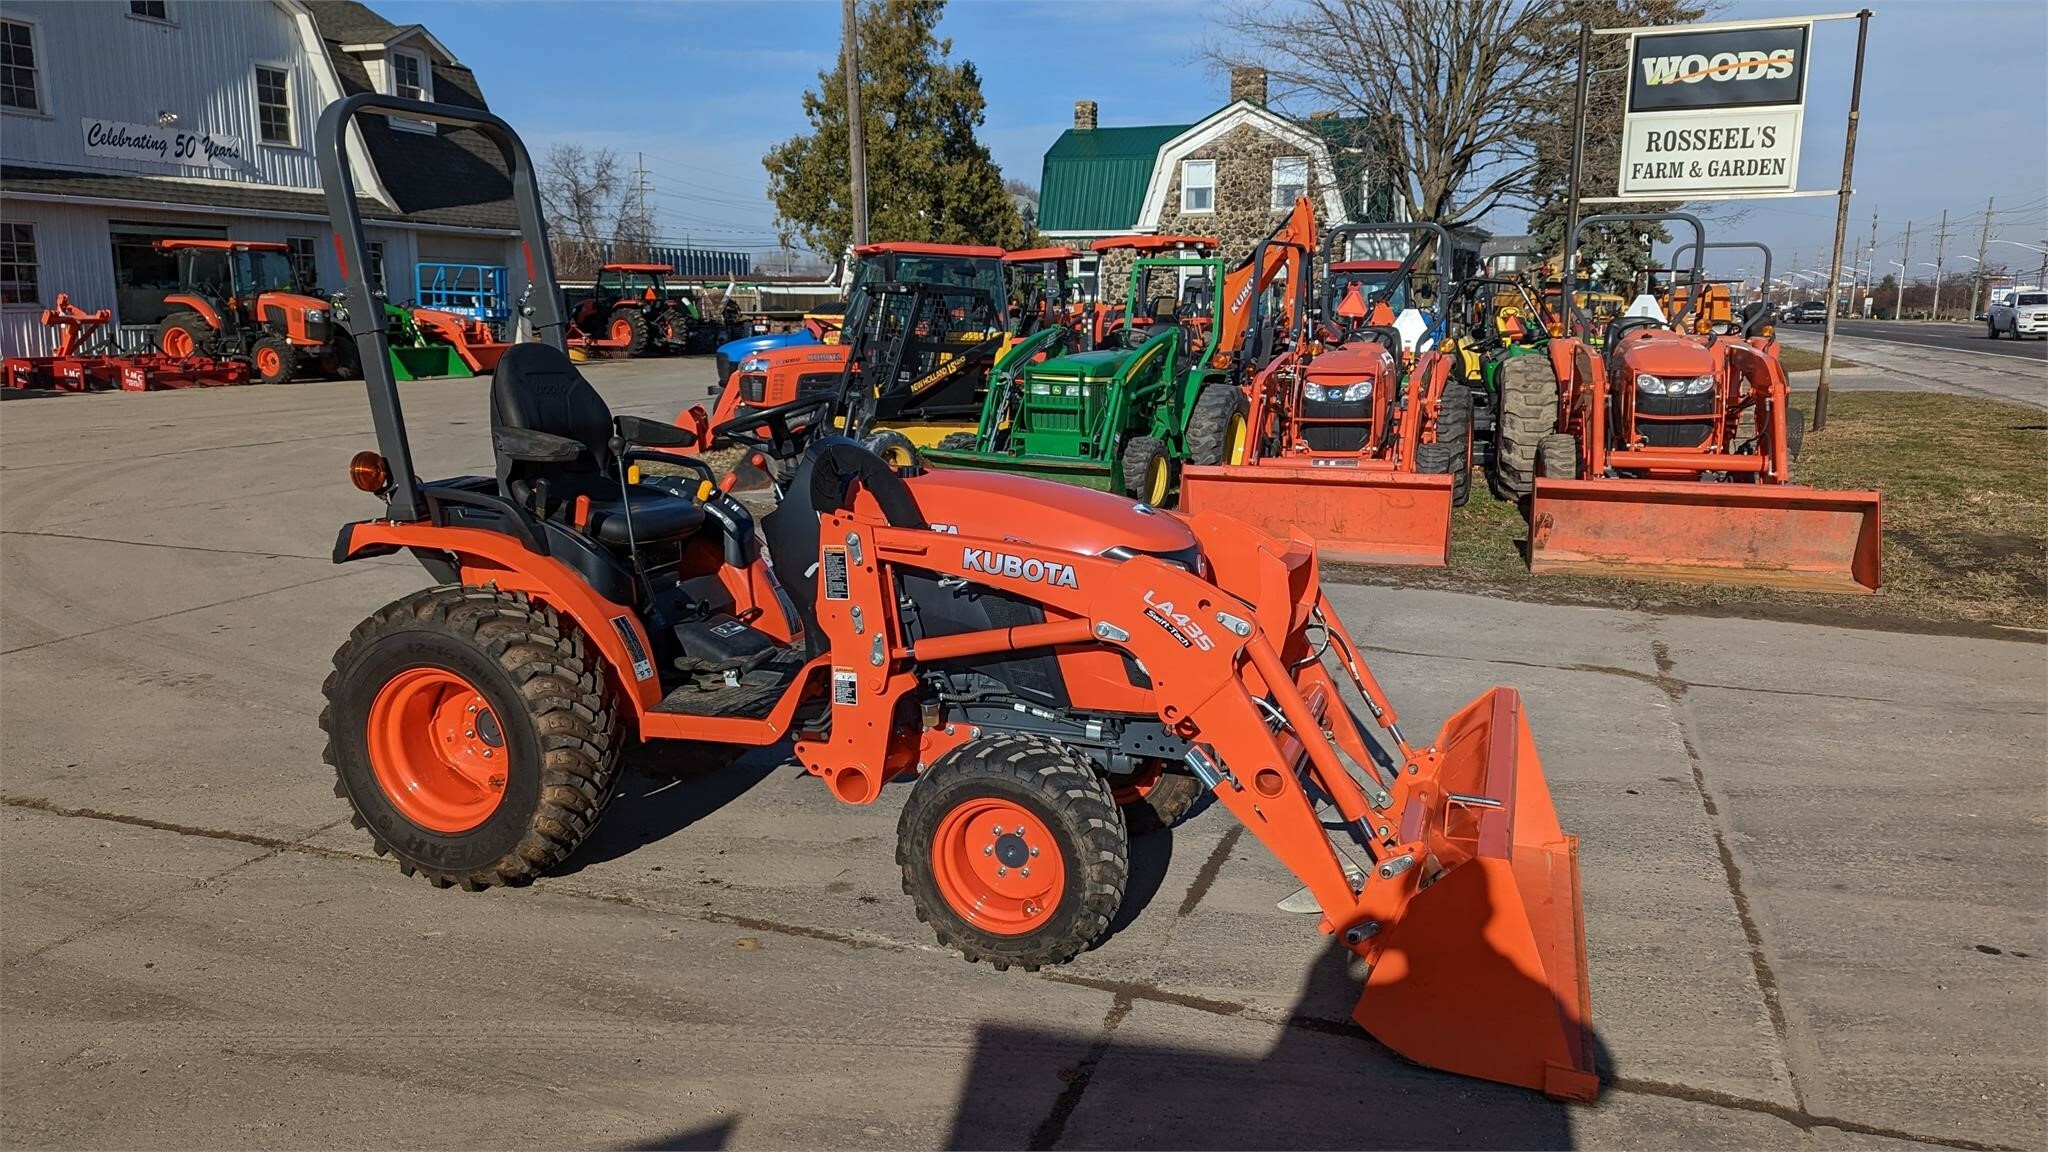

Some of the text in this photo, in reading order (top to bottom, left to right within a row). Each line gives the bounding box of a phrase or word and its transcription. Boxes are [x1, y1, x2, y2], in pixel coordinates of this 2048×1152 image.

[1641, 48, 1795, 86] WOODS
[87, 122, 240, 161] Celebrating 50 Years
[1645, 125, 1777, 153] ROSSEEL'S
[1631, 158, 1787, 180] FARM & GARDEN
[1231, 278, 1254, 314] KUBO
[923, 366, 948, 387] HOLLAND
[962, 547, 1079, 589] KUBOTA
[1143, 590, 1216, 651] LA435
[1146, 609, 1190, 647] Swift-Tach
